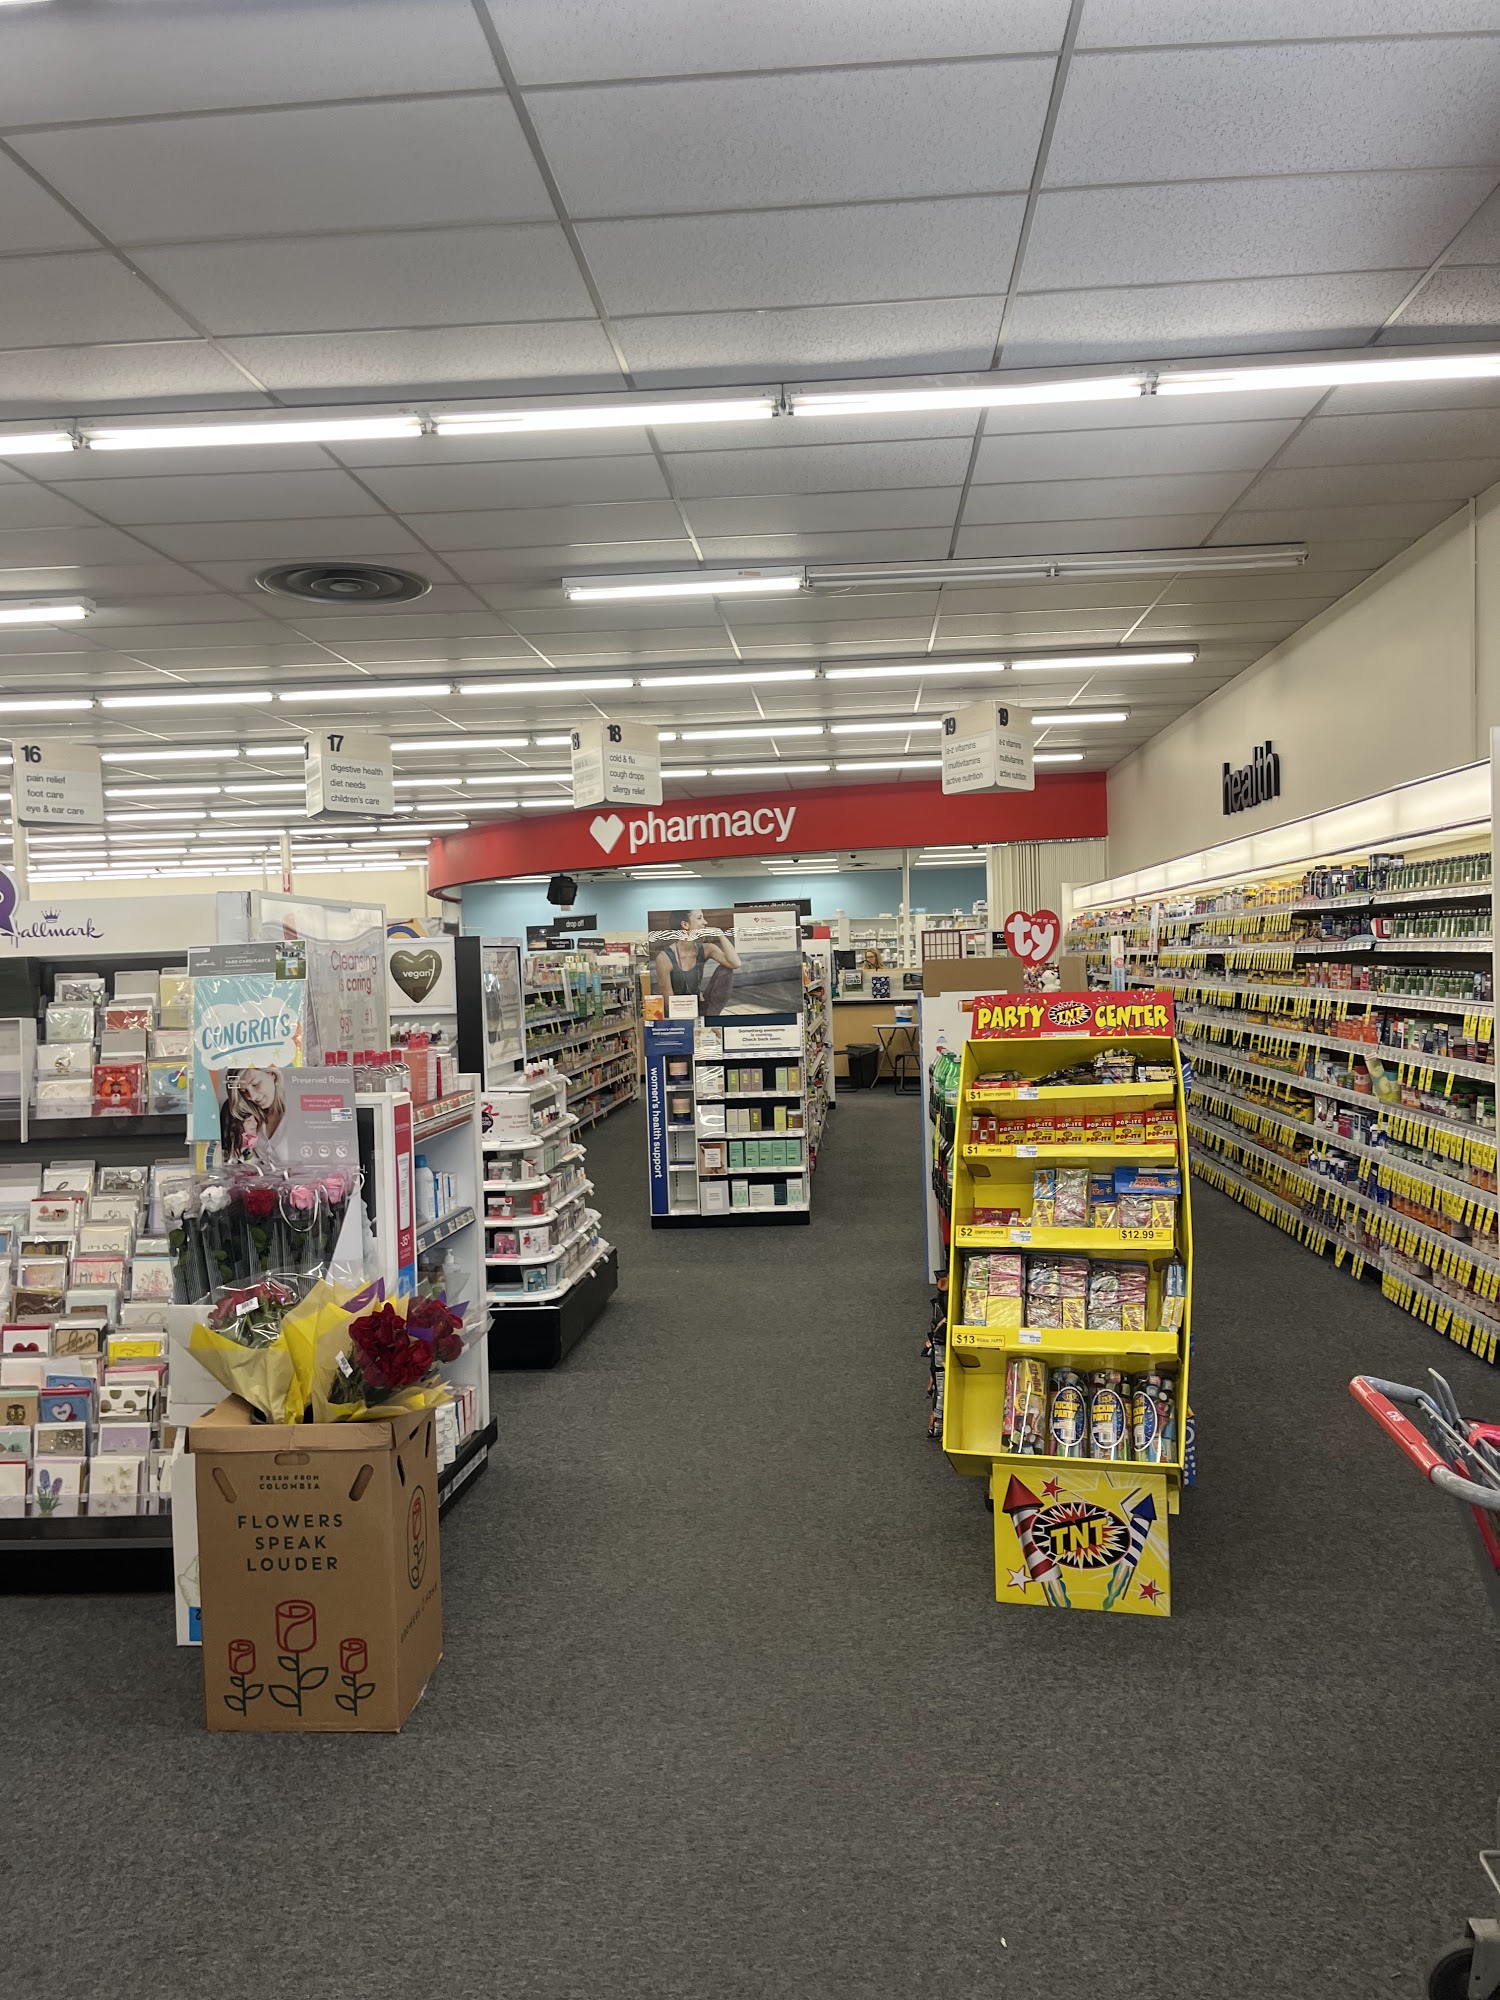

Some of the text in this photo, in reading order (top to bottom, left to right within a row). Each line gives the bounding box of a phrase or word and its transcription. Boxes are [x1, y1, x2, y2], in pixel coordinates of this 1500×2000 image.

[943, 717, 956, 736] 19
[607, 724, 622, 743] 18
[326, 734, 344, 752] 17
[955, 742, 976, 752] vitamins
[20, 745, 42, 763] 16
[609, 754, 622, 763] cold
[628, 756, 636, 764] flu
[330, 763, 384, 776] digestive health
[947, 757, 981, 770] multivitamins
[26, 774, 66, 784] pain relief
[609, 770, 645, 781] cough drops
[946, 772, 983, 785] active nutrition
[1222, 741, 1280, 815] health
[330, 779, 366, 790] diet needs
[612, 785, 646, 795] allergy relief
[27, 789, 64, 799] foot care
[330, 794, 380, 806] children's care
[26, 804, 84, 816] eye & ear care
[628, 806, 797, 854] pharmacy
[565, 920, 577, 929] drop
[1007, 913, 1055, 961] ty
[331, 950, 377, 975] Cleansing
[402, 970, 431, 980] vegan
[346, 974, 372, 995] caring
[976, 1004, 1170, 1031] PARTY TNT CENTER
[201, 1013, 291, 1050] CONGRATS
[291, 1076, 350, 1084] Preserved Roses
[970, 1091, 981, 1100] $1
[650, 1067, 663, 1179] women's health support
[967, 1146, 978, 1154] $1
[960, 1227, 973, 1237] $2
[1121, 1230, 1154, 1239] $12.99
[956, 1334, 975, 1344] $13
[238, 1513, 343, 1529] FLOWERS
[255, 1535, 327, 1550] SPEAK
[1050, 1517, 1108, 1555] TNT
[246, 1556, 338, 1572] LOUDER
